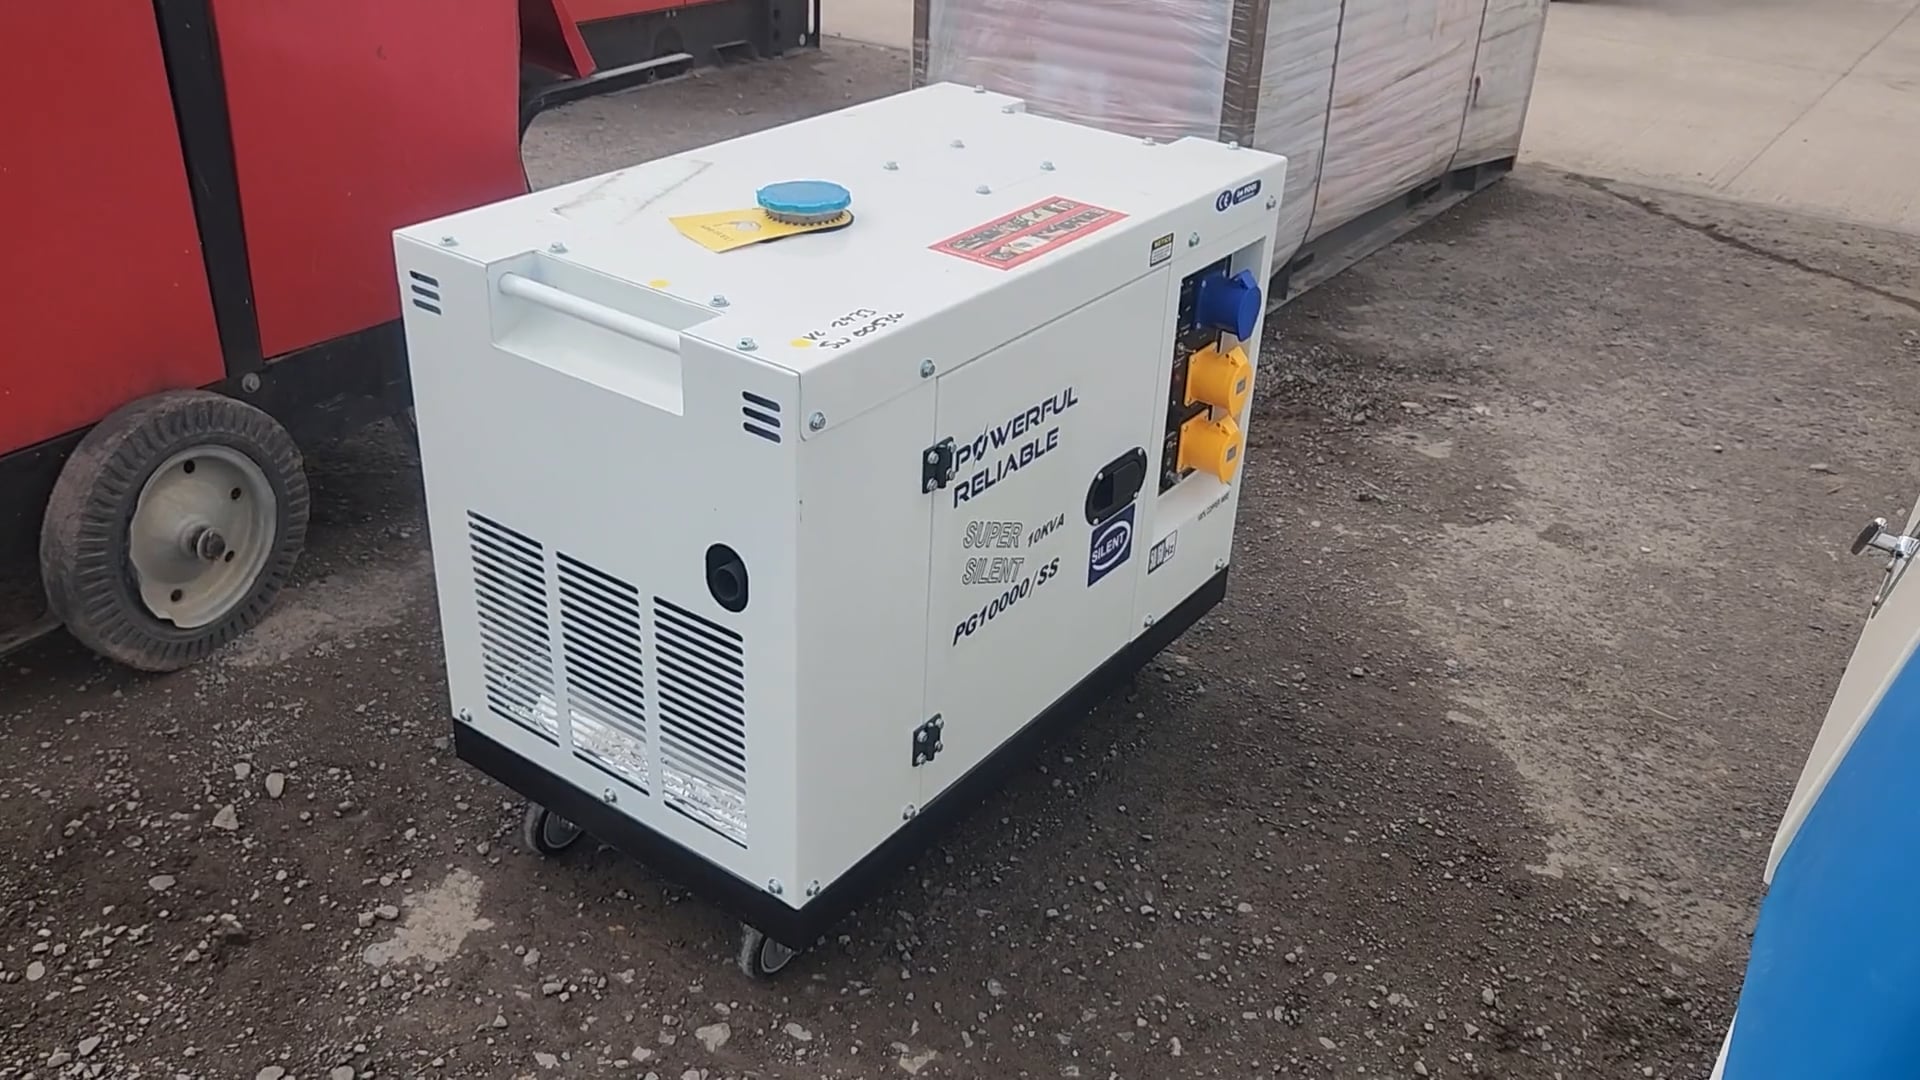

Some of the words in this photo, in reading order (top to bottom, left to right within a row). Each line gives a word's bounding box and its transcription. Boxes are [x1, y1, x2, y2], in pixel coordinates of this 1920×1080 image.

[955, 386, 1078, 473] POWERFUL
[953, 426, 1059, 509] RELIABLE
[963, 520, 1023, 549] SUPER
[1027, 512, 1065, 548] 10KVA
[1091, 530, 1126, 564] SILENT
[961, 557, 1025, 585] SILENT
[952, 557, 1060, 647] PG10000/SS
